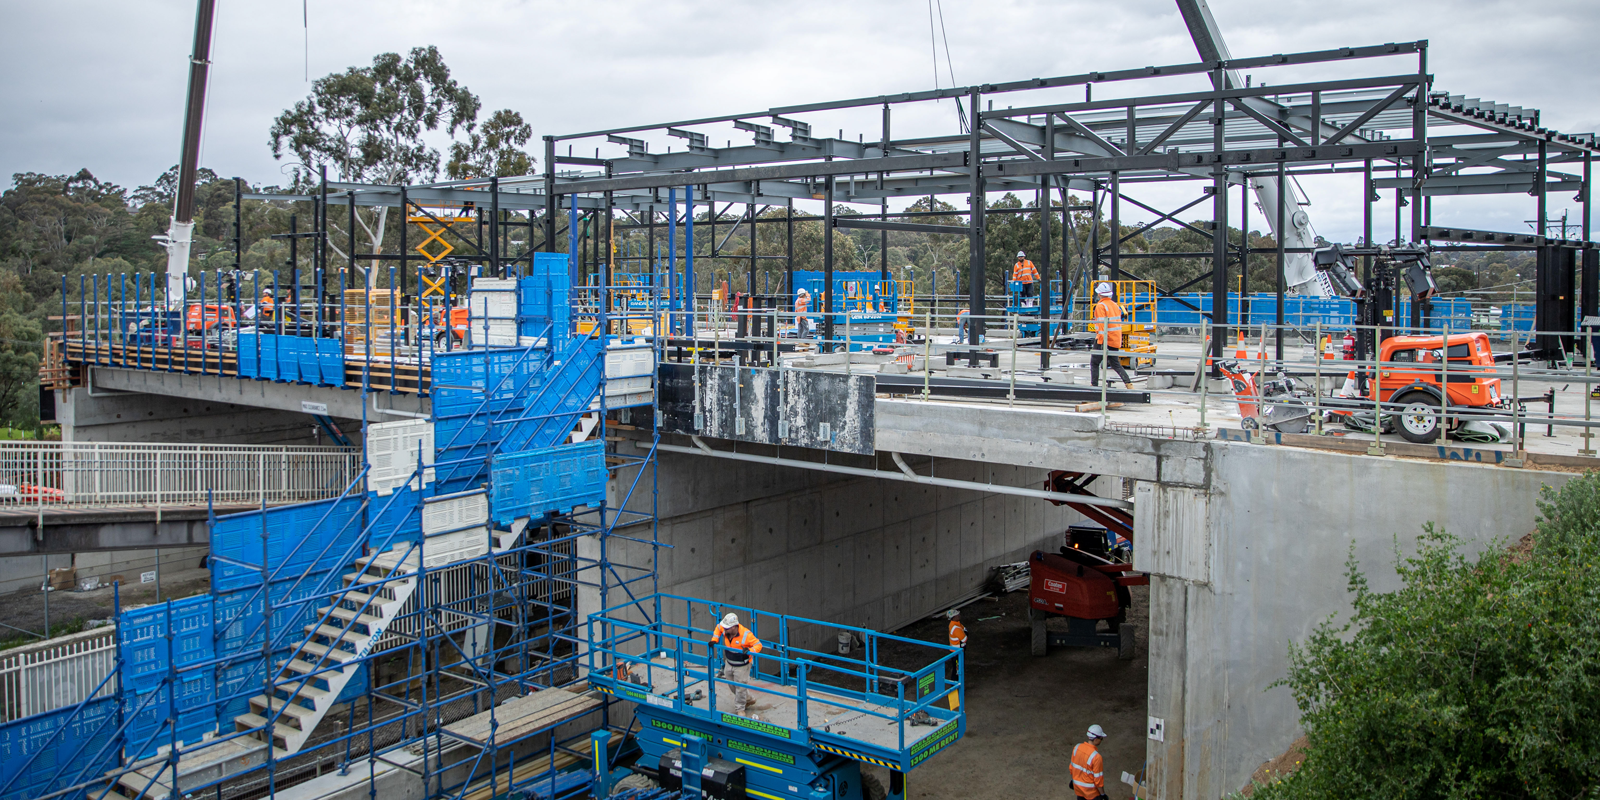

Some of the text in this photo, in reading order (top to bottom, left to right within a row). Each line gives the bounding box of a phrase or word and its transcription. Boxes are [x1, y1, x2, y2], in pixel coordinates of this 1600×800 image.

[651, 719, 714, 742] 1300 ME RENT
[722, 713, 789, 733] MELBOURNE
[911, 719, 958, 750] MELBOURNE
[728, 739, 794, 759] MELBOURNE
[911, 731, 959, 767] 1300 ME RENT
